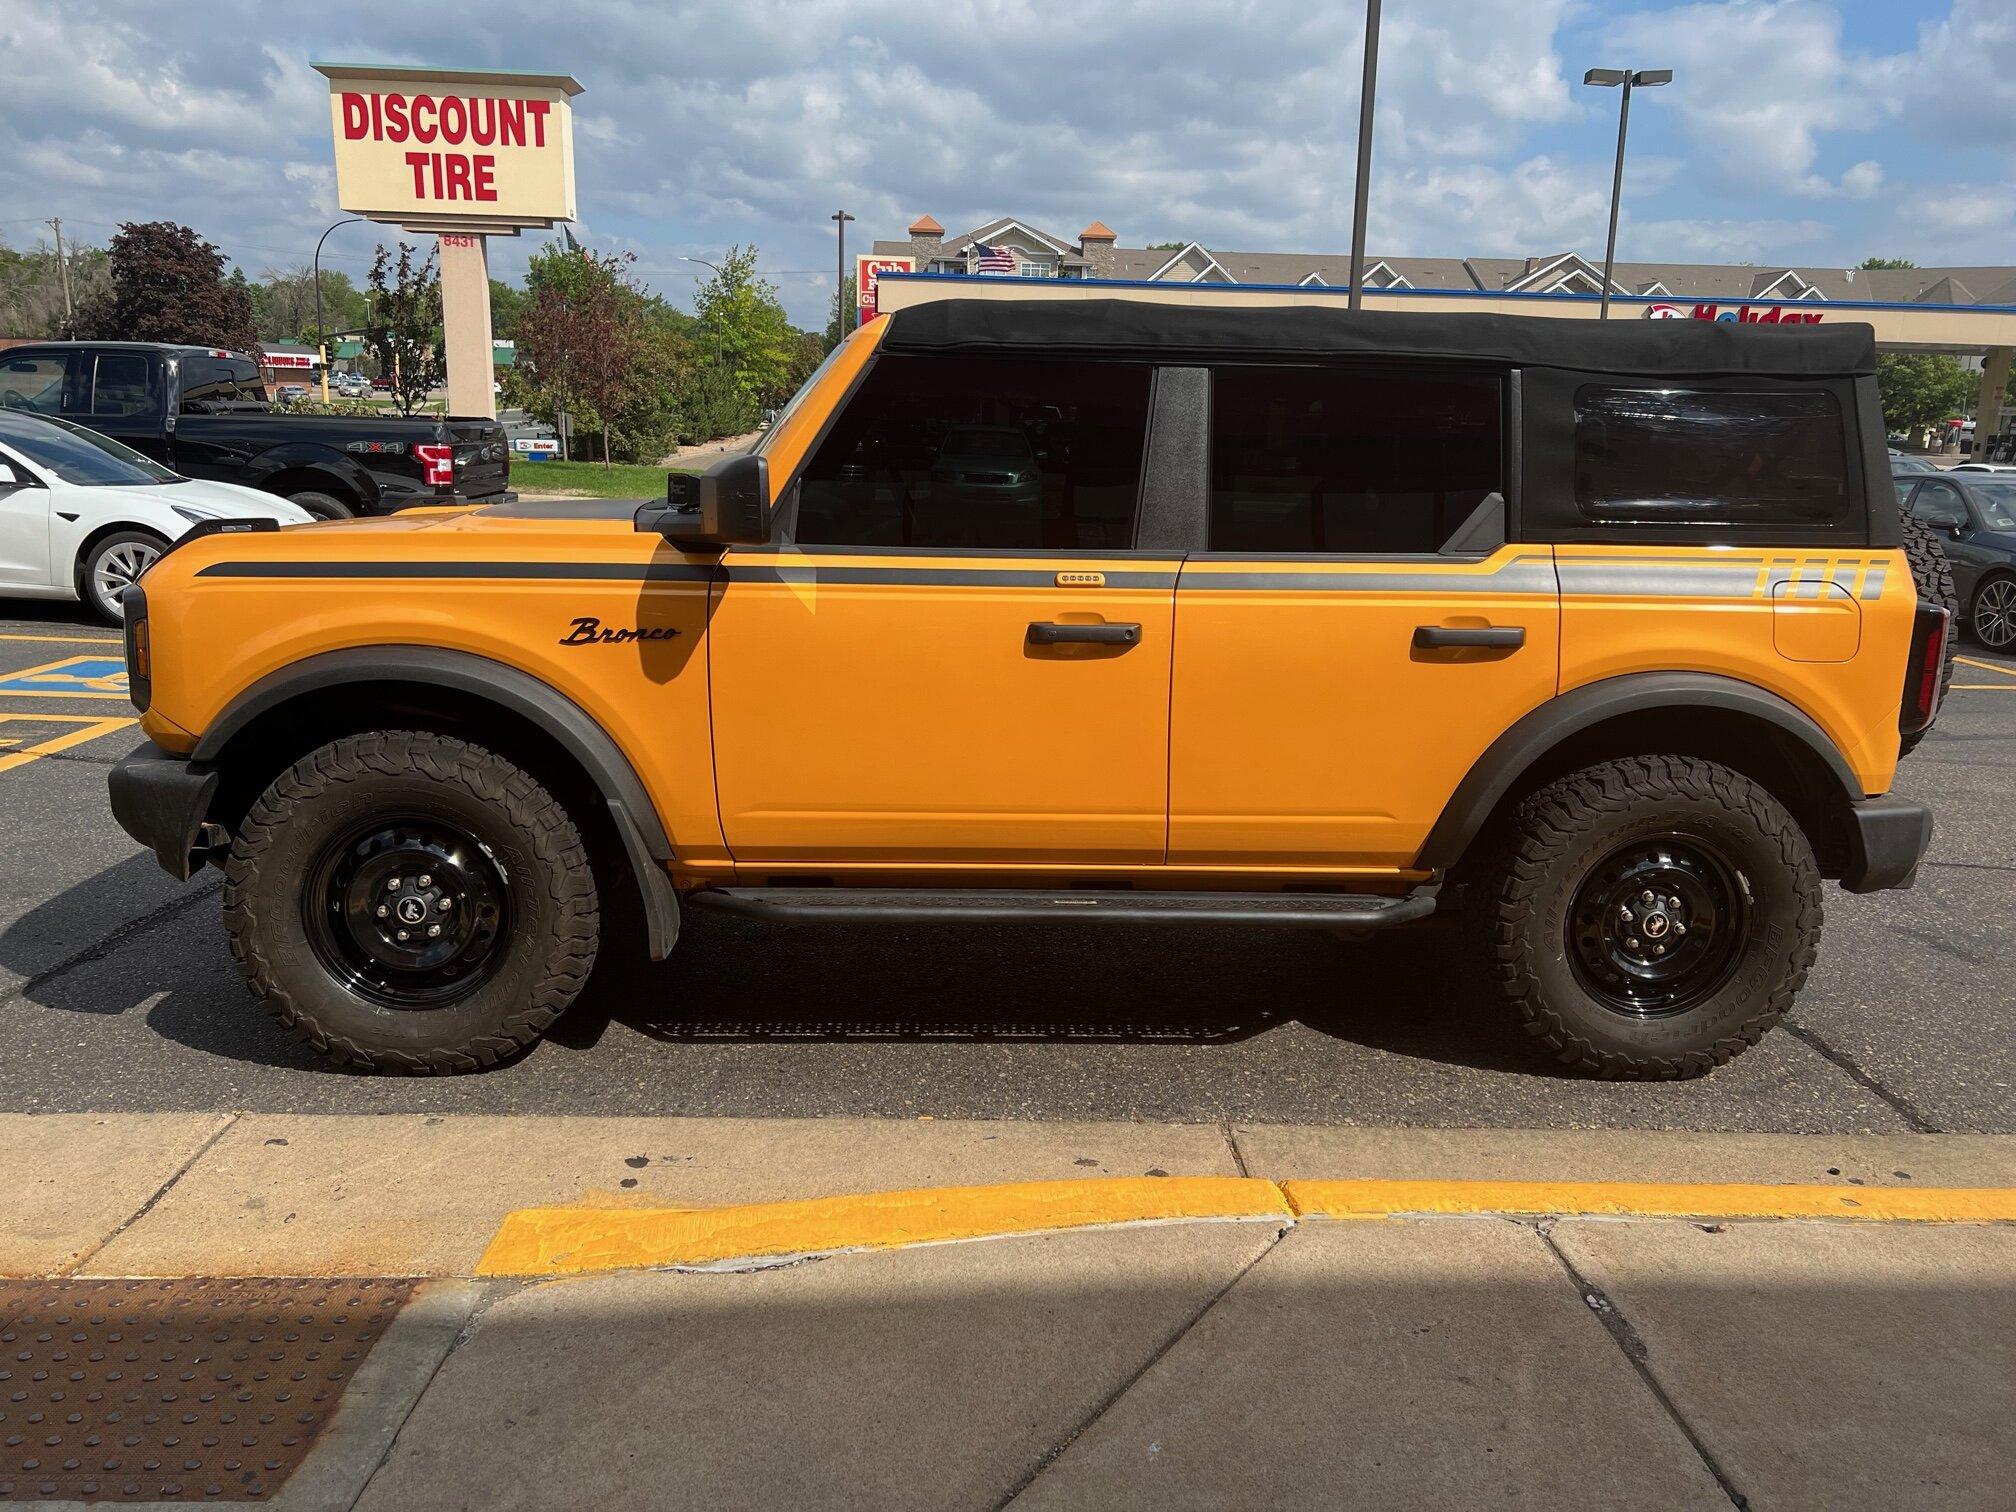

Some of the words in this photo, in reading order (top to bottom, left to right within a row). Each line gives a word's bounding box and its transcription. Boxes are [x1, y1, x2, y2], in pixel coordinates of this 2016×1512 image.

[342, 92, 550, 147] DISCOUNT
[405, 152, 497, 201] TIRE
[443, 235, 474, 247] 8431
[862, 294, 875, 303] Cu
[1694, 304, 1824, 324] Holiday
[559, 617, 681, 646] Bronco
